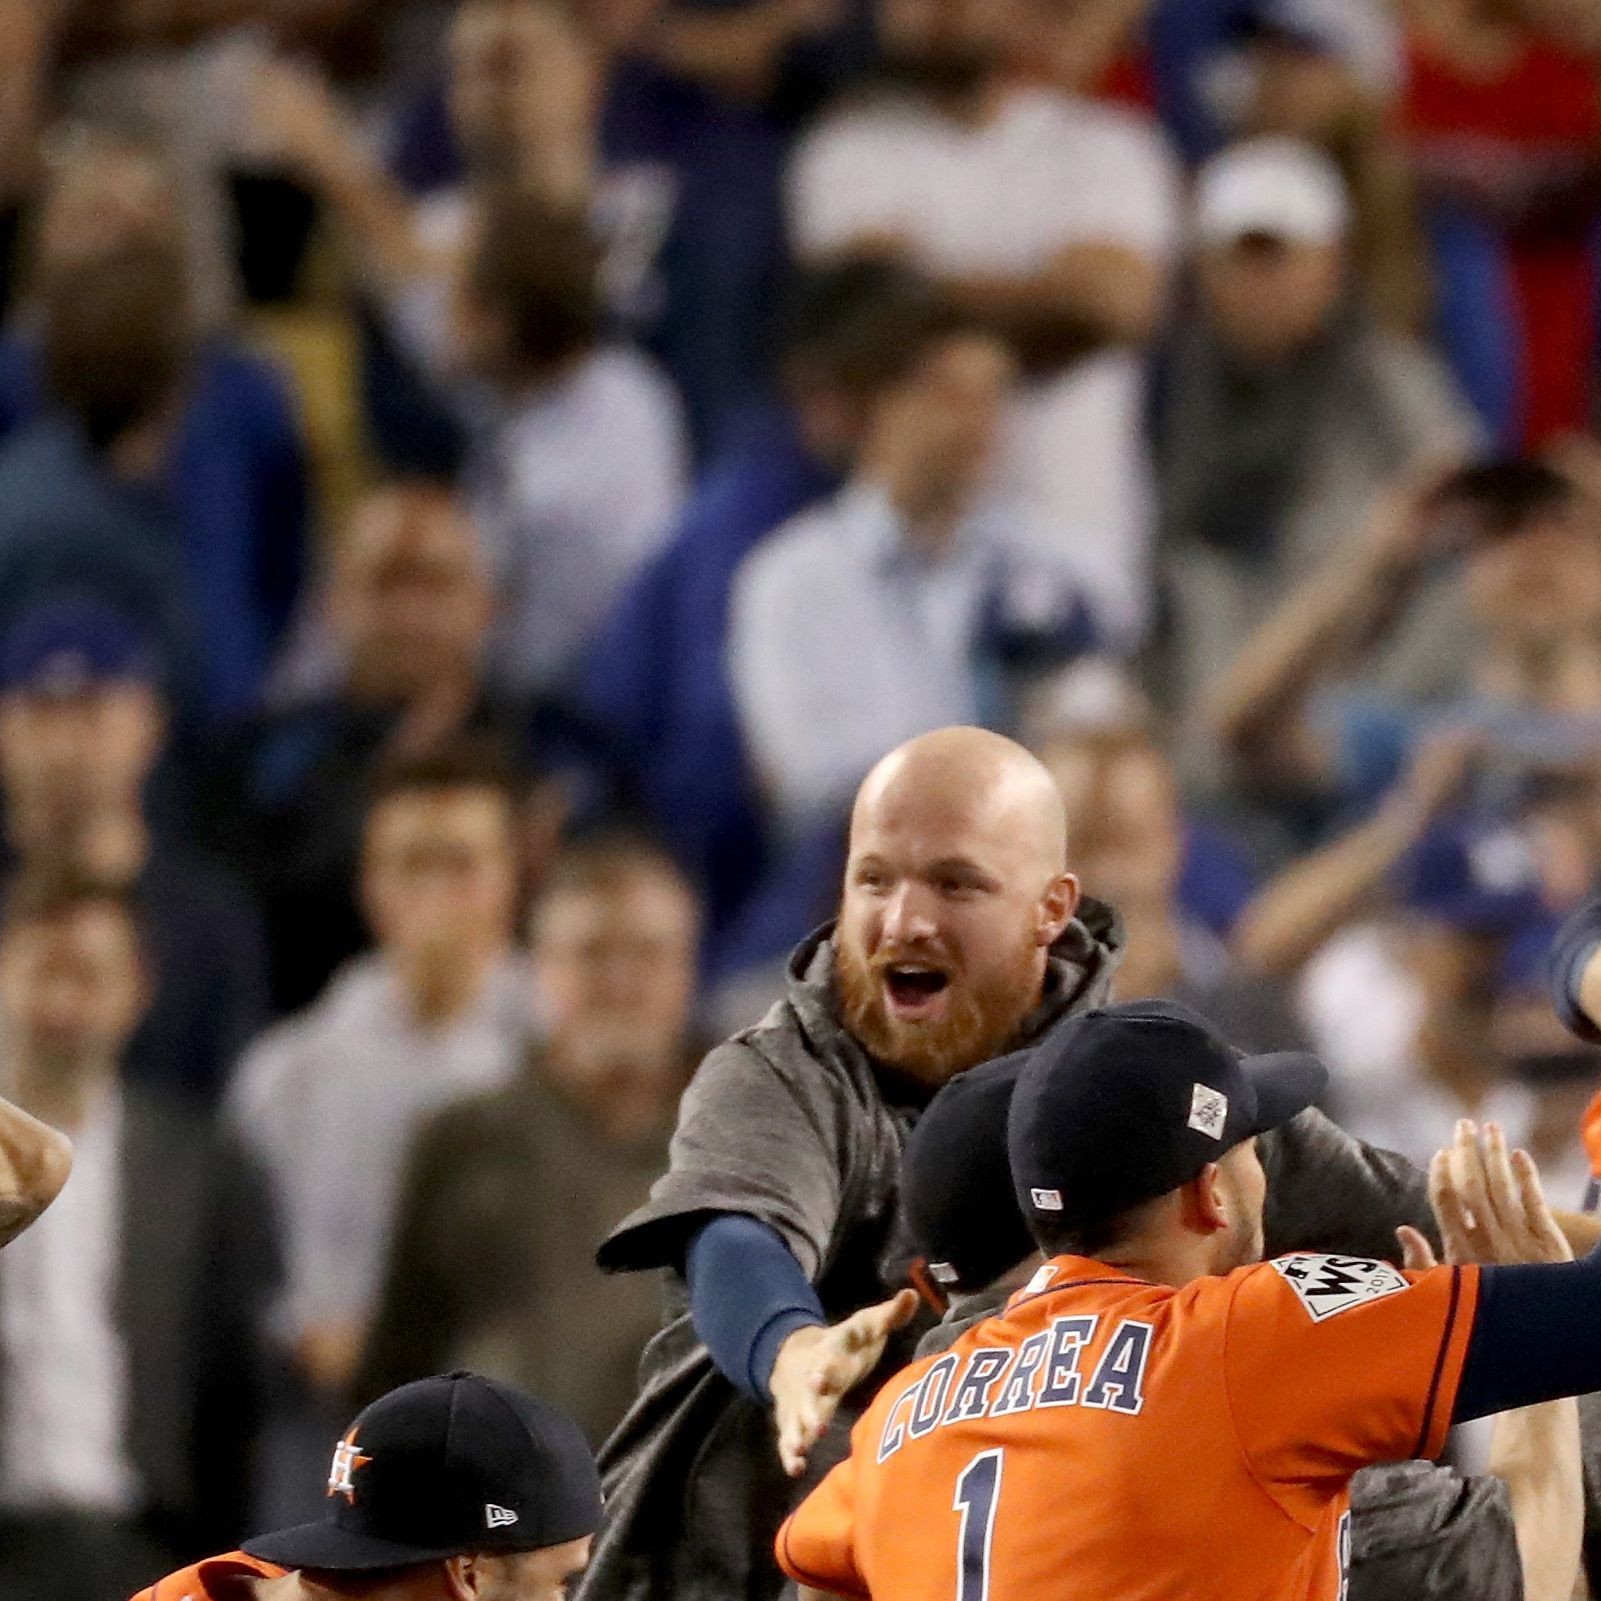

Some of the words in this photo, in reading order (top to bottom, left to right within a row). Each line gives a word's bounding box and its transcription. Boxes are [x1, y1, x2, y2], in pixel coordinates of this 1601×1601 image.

[1304, 1257, 1378, 1296] WS
[1366, 1268, 1390, 1295] 2017
[877, 1314, 1154, 1464] CORREA
[328, 1441, 364, 1490] H
